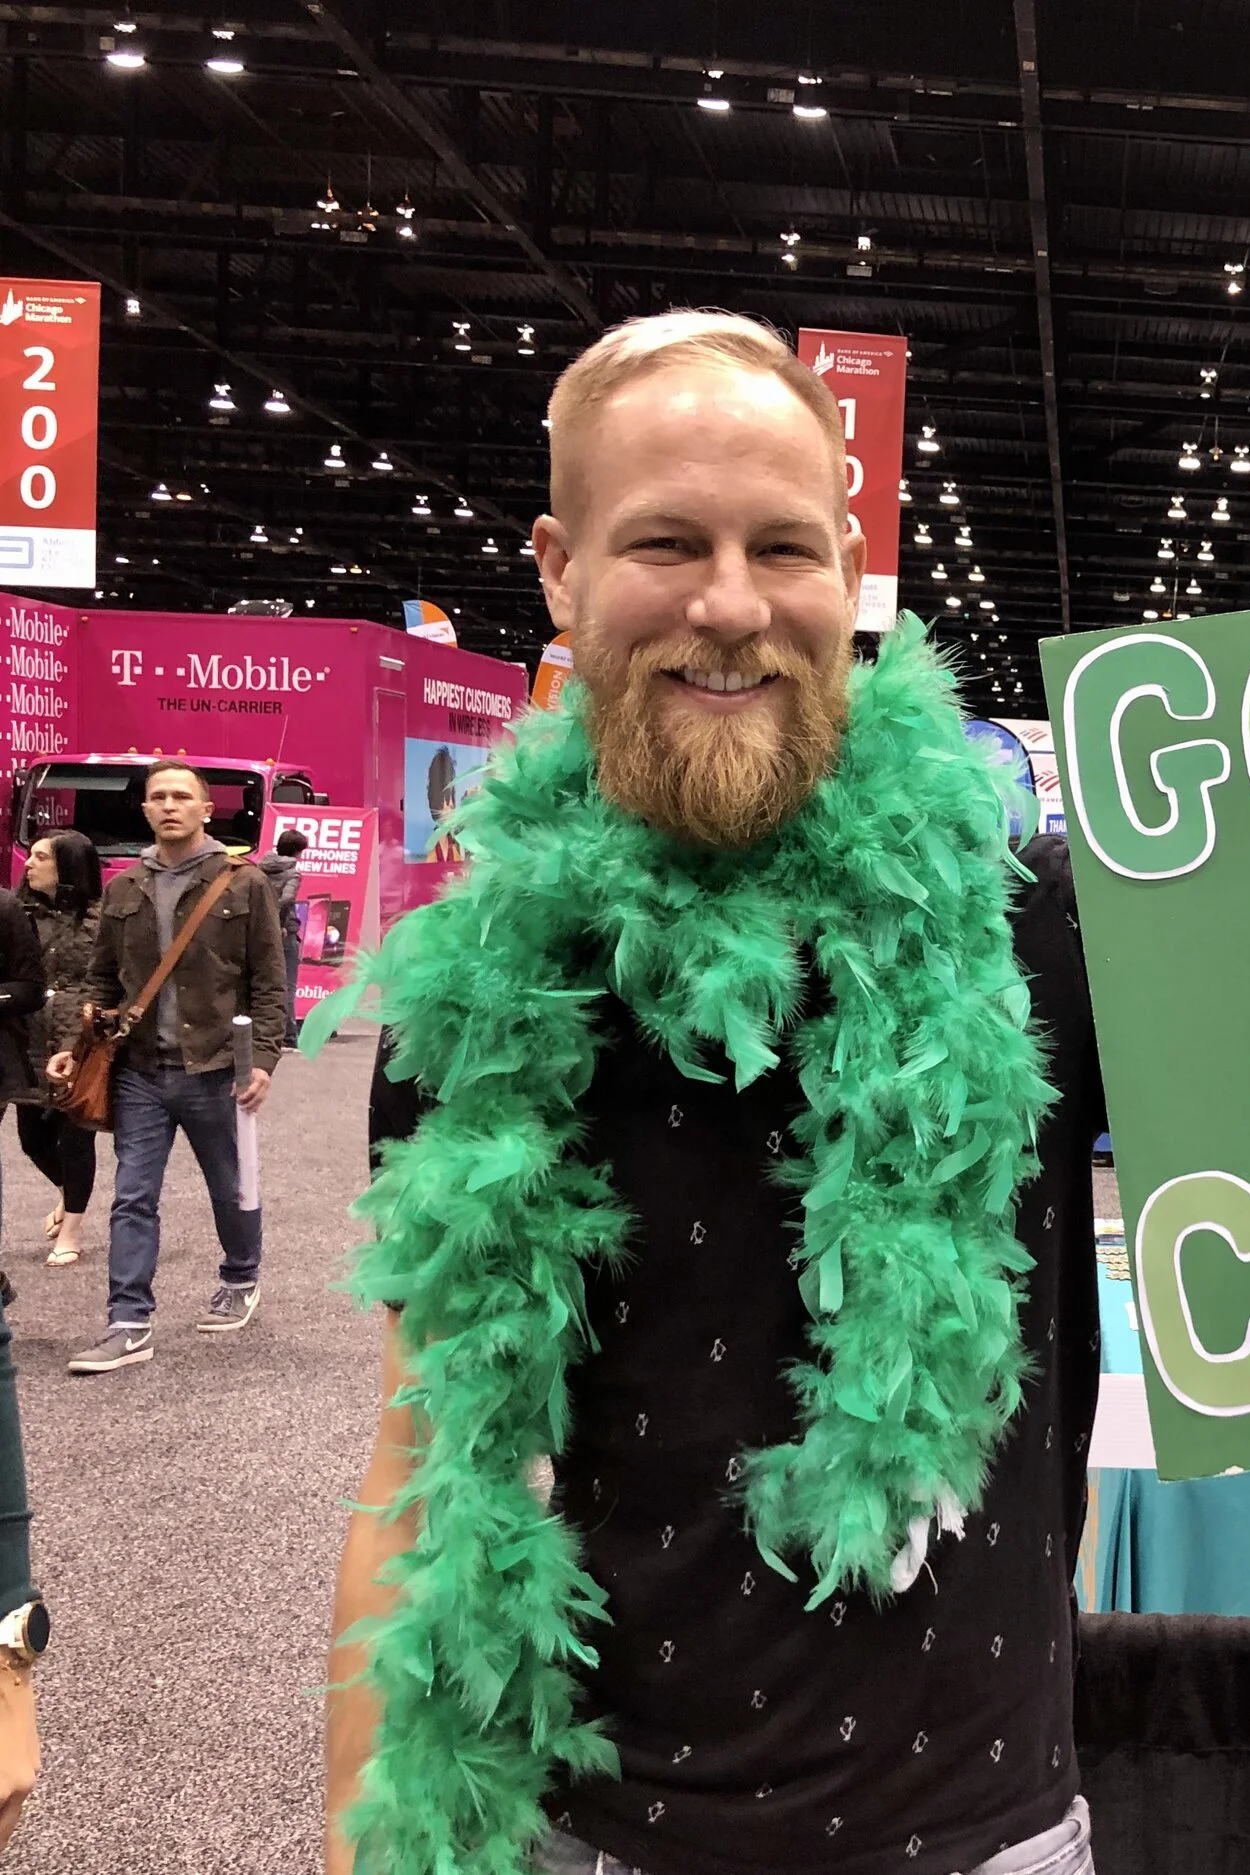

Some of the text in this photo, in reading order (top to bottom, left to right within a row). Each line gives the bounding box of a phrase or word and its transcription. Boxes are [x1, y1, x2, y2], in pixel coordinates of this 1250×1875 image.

[25, 303, 64, 315] Chicago
[25, 312, 72, 324] Marathon
[836, 355, 872, 367] Chicago
[836, 364, 880, 376] Marathon
[157, 698, 283, 714] THE UN-CARRIER
[423, 677, 512, 720] HAPPIEST CUSTOMERS
[448, 712, 491, 739] IN WIRELESS
[273, 815, 363, 850] FREE
[296, 860, 356, 875] NEW LINES
